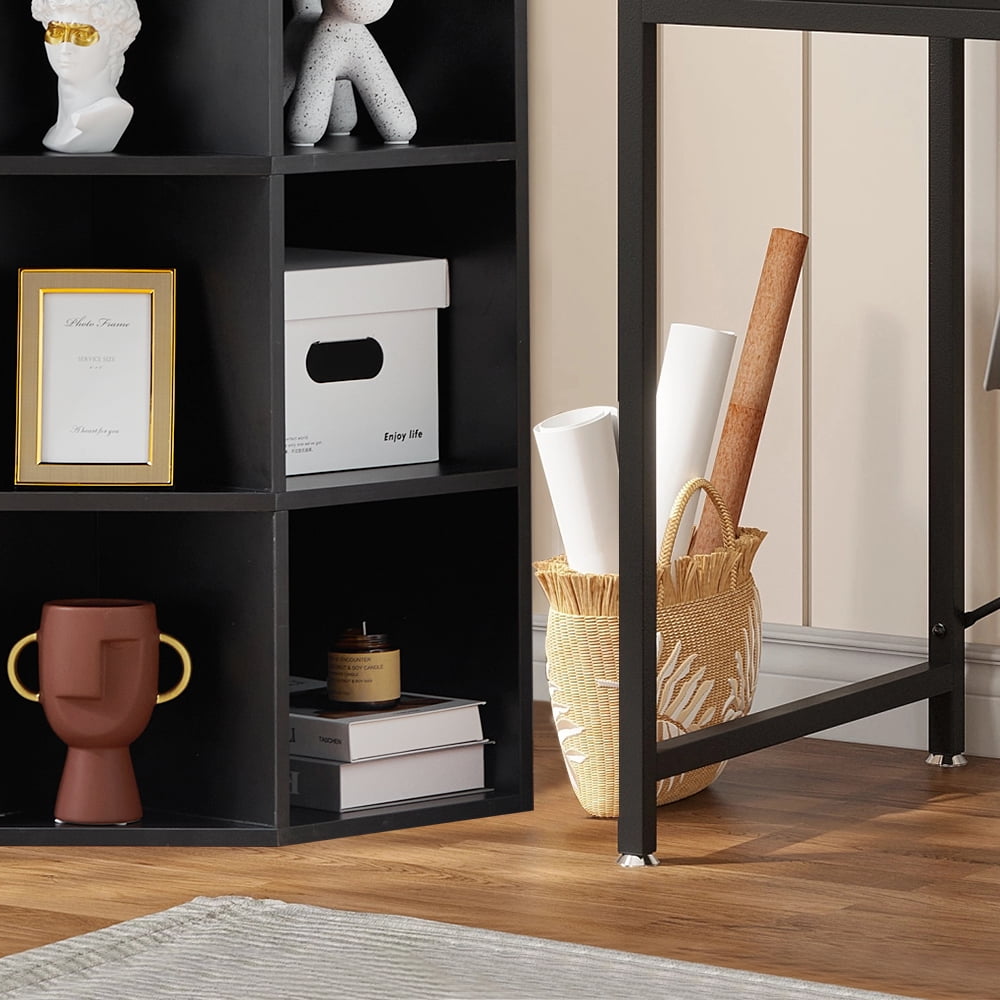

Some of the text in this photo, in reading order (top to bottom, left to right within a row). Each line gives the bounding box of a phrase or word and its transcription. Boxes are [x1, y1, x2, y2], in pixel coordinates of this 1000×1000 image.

[64, 314, 130, 328] Photo Frame
[384, 429, 423, 443] Enjoy life
